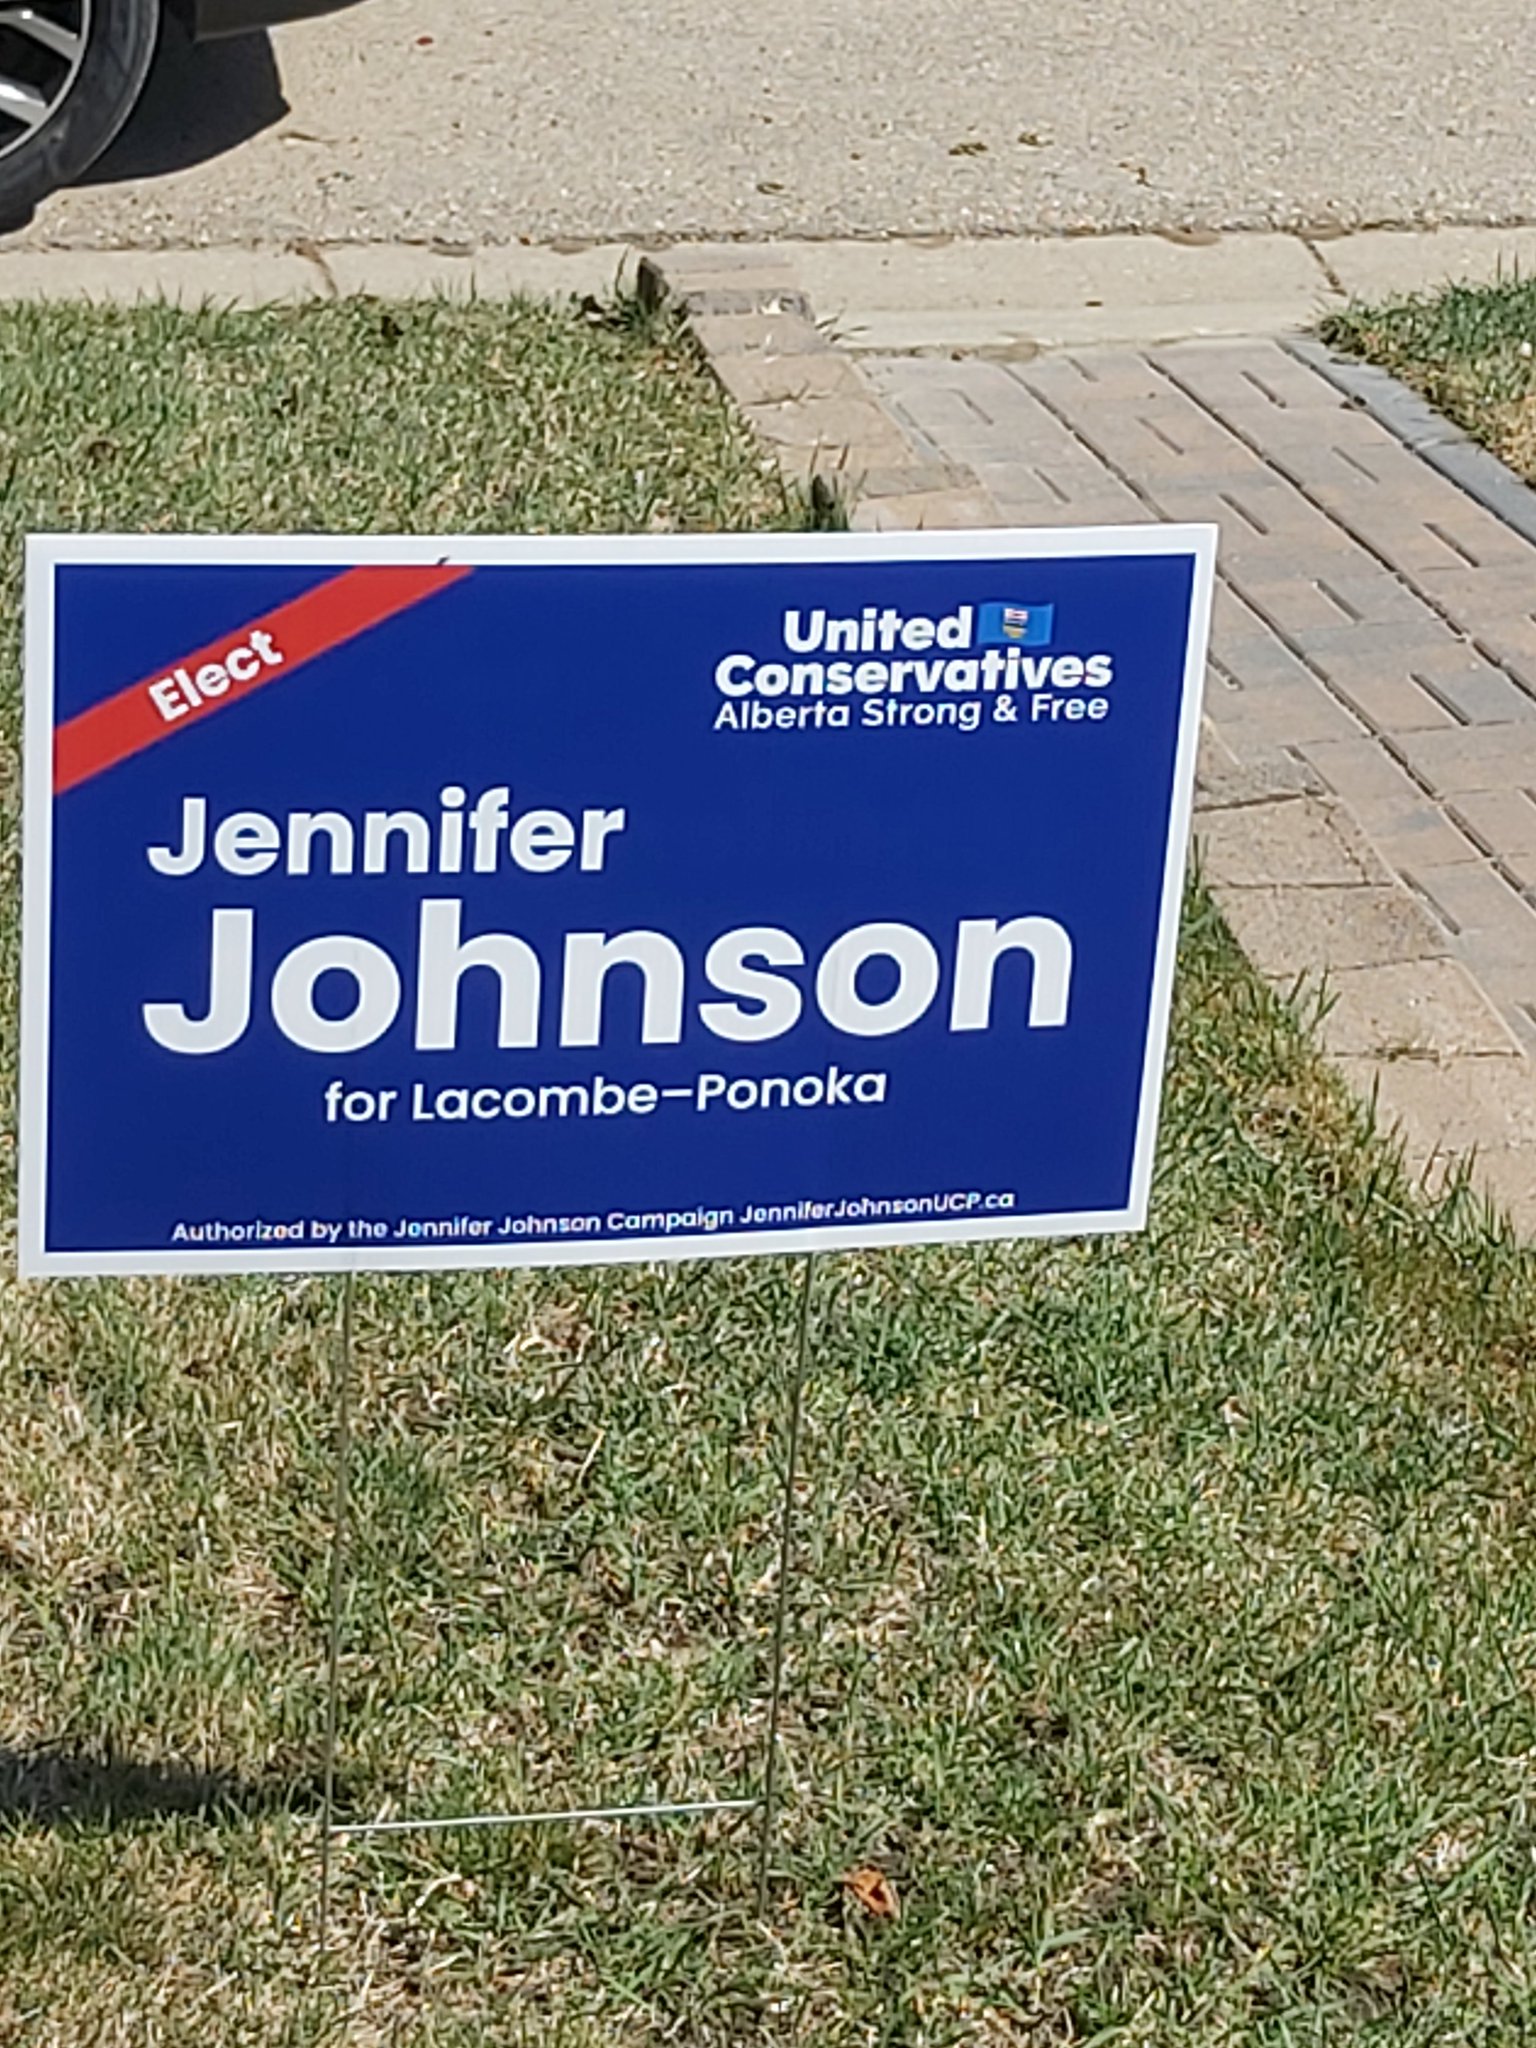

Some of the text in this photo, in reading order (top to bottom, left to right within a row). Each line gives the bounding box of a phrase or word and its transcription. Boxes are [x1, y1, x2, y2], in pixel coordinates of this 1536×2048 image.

[784, 605, 974, 653] United
[147, 627, 284, 724] Elect
[715, 645, 1114, 698] Conservatives
[713, 693, 1110, 732] Alberta Strong & Free
[146, 786, 626, 876] Jennifer
[142, 898, 1073, 1054] Johnson
[324, 1081, 396, 1122] for
[171, 1192, 1016, 1244] Authorized by the Jennifer Johnson Campaign JenniferJohnsonUCP.ca
